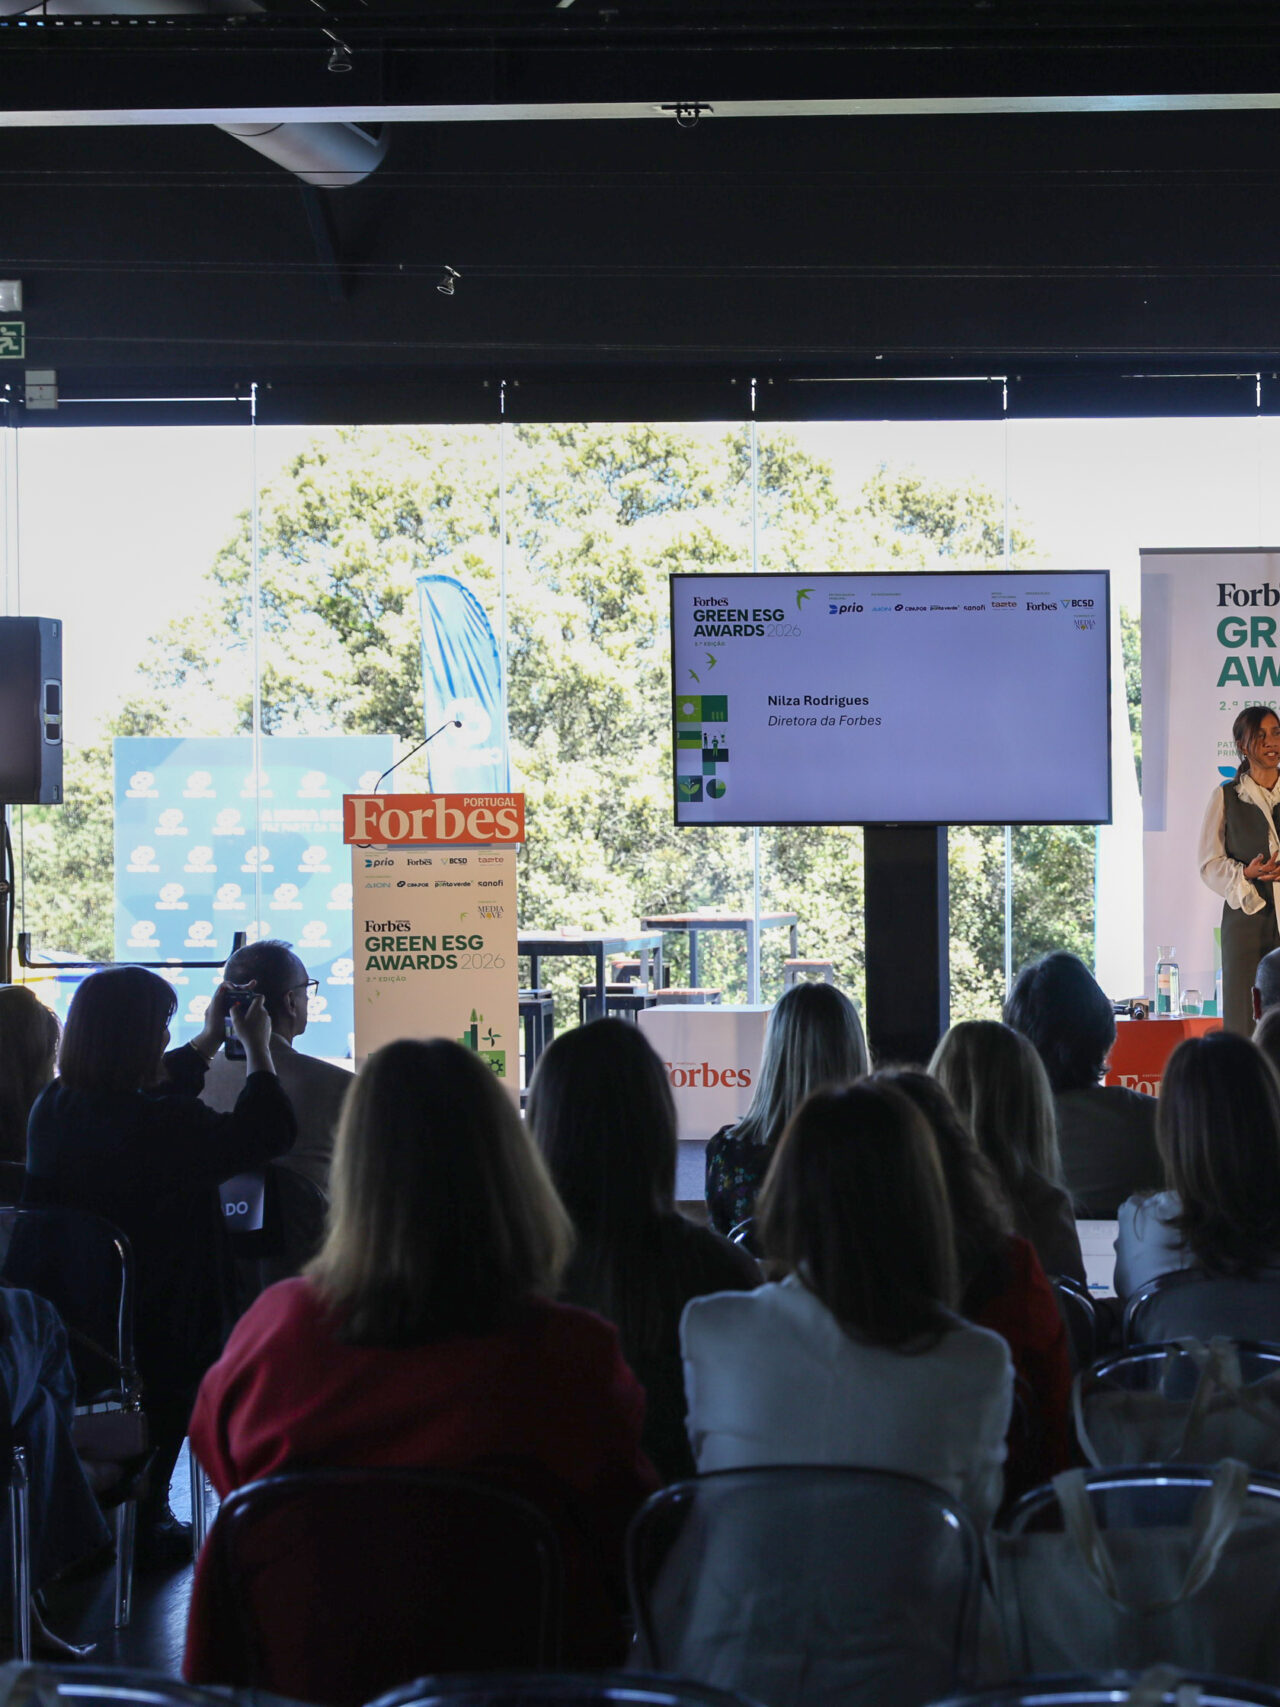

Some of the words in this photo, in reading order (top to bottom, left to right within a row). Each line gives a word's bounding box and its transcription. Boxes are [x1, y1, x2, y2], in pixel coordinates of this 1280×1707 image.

[693, 596, 729, 607] Forbes
[1026, 601, 1058, 611] Forbes
[1071, 599, 1095, 608] BCSD
[693, 609, 749, 622] GREEN
[752, 608, 785, 622] ESG
[839, 602, 864, 615] prio
[693, 624, 765, 637] AWARDS
[767, 623, 802, 637] 2026
[768, 695, 800, 706] Nilza
[804, 694, 870, 708] Rodrigues
[768, 714, 817, 727] Diretora
[820, 714, 836, 727] da
[839, 714, 882, 726] Forbes
[463, 797, 517, 807] PORTUGAL
[348, 798, 520, 841] Forbes
[374, 857, 395, 868] prio
[449, 857, 468, 865] BCSD
[365, 920, 411, 932] Forbes
[365, 935, 436, 953] GREEN
[442, 935, 484, 951] ESG
[365, 954, 458, 971] AWARDS
[460, 952, 506, 970] 2026
[664, 1062, 752, 1088] orbes
[223, 1200, 249, 1216] DO
